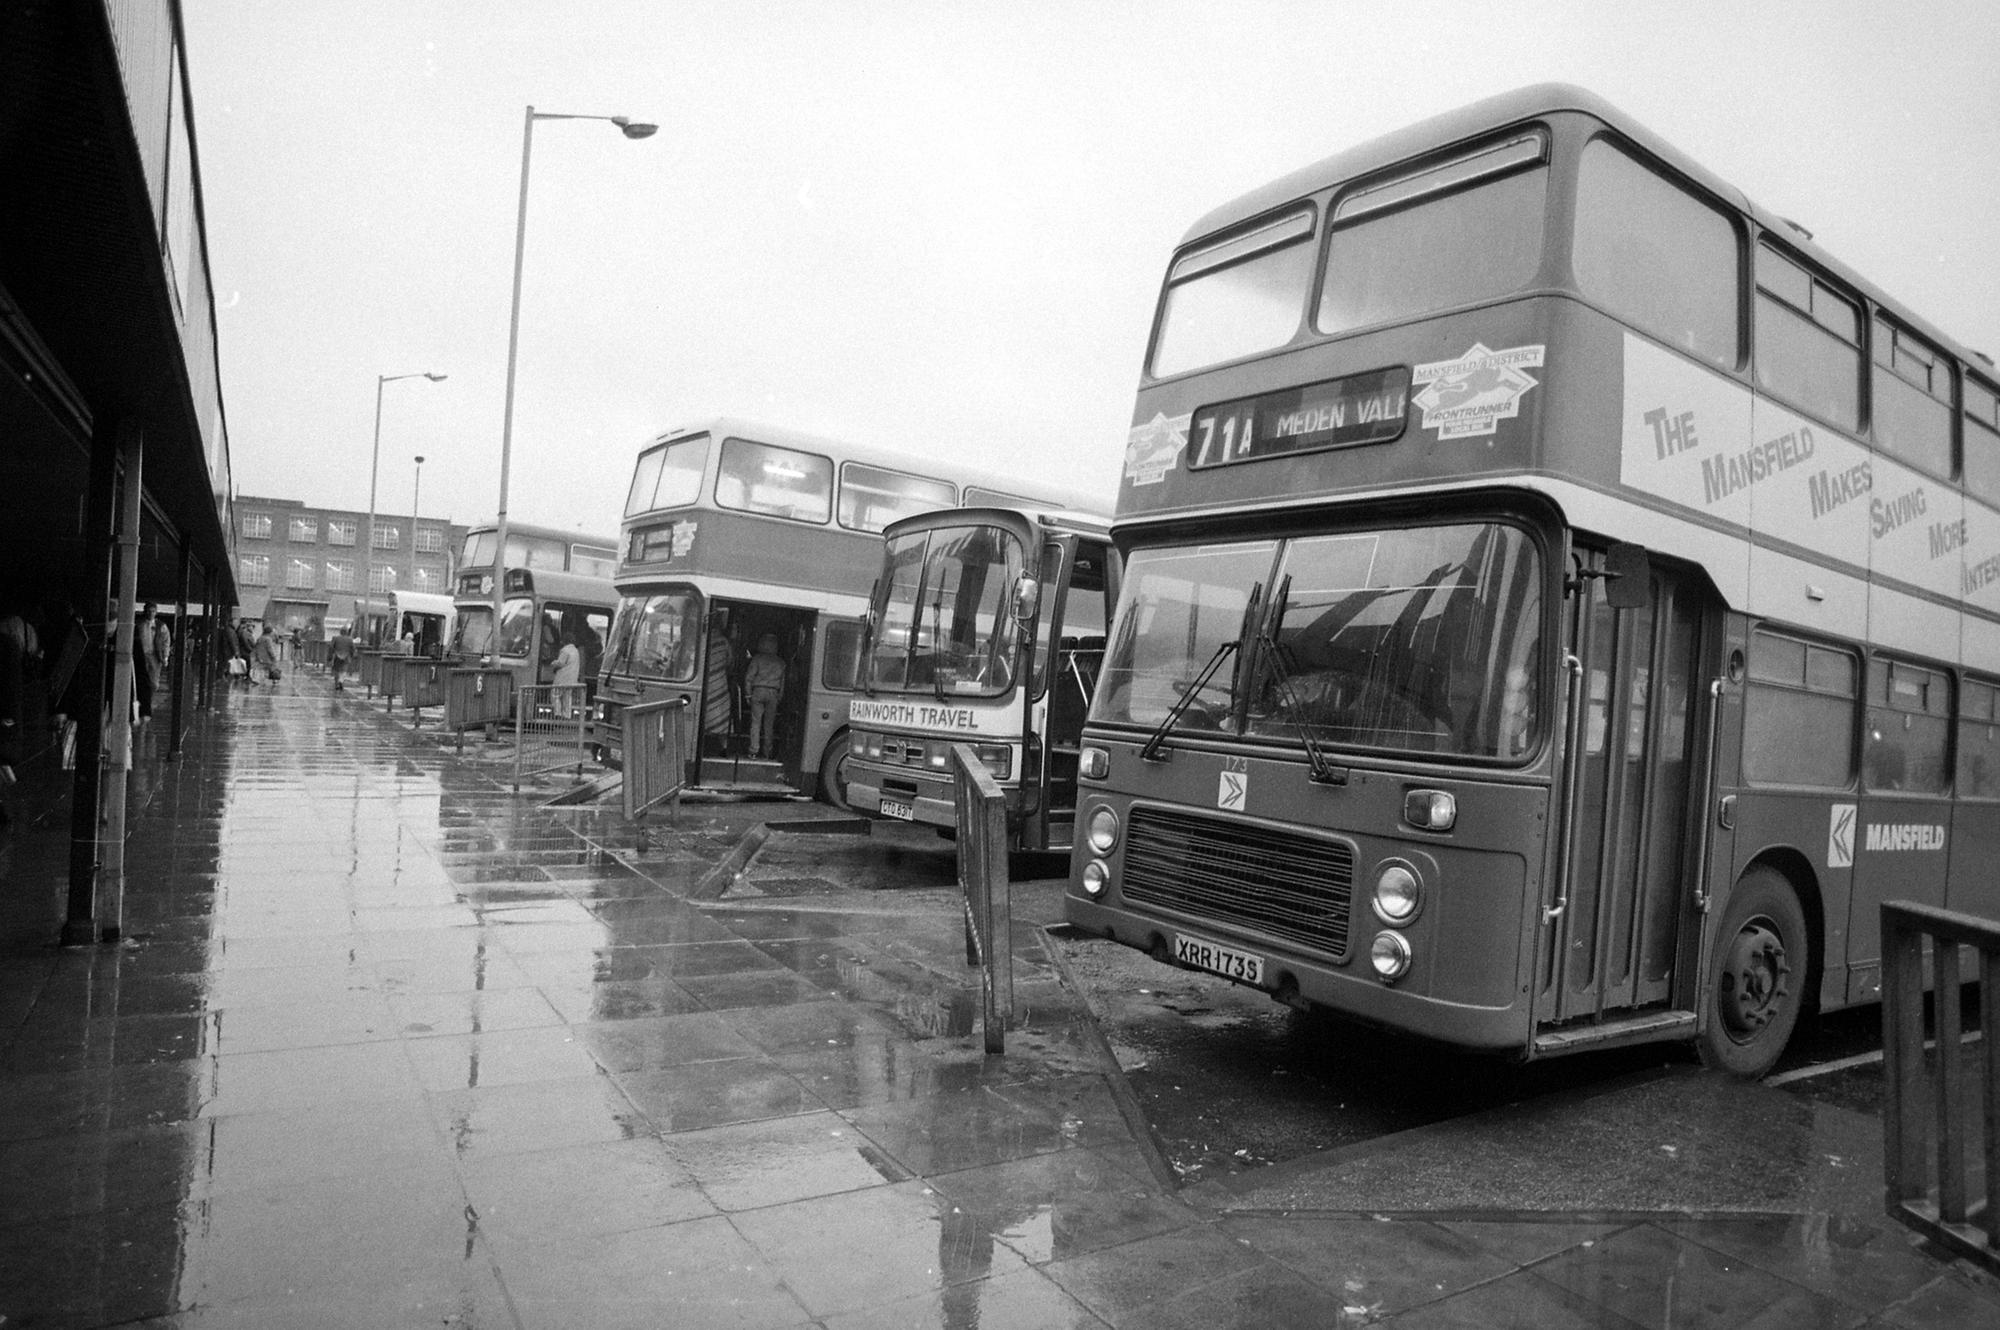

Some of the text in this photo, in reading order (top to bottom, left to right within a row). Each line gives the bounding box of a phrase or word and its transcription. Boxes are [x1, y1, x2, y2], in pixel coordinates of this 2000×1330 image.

[1416, 360, 1476, 380] MANSFIELD
[1276, 403, 1346, 438] MEDEN
[1196, 417, 1253, 466] 71A
[1643, 406, 1699, 460] THE
[1701, 426, 1814, 504] MANSFIELD
[1808, 460, 1872, 520] MAKES
[1869, 486, 1927, 540] SAVING
[1928, 517, 1969, 560] MORE
[430, 666, 436, 680] 7
[476, 675, 483, 692] 6
[852, 701, 978, 728] RAINWORTH TRAVEL
[1226, 756, 1248, 773] 173
[1865, 823, 1945, 851] MANSFIELD
